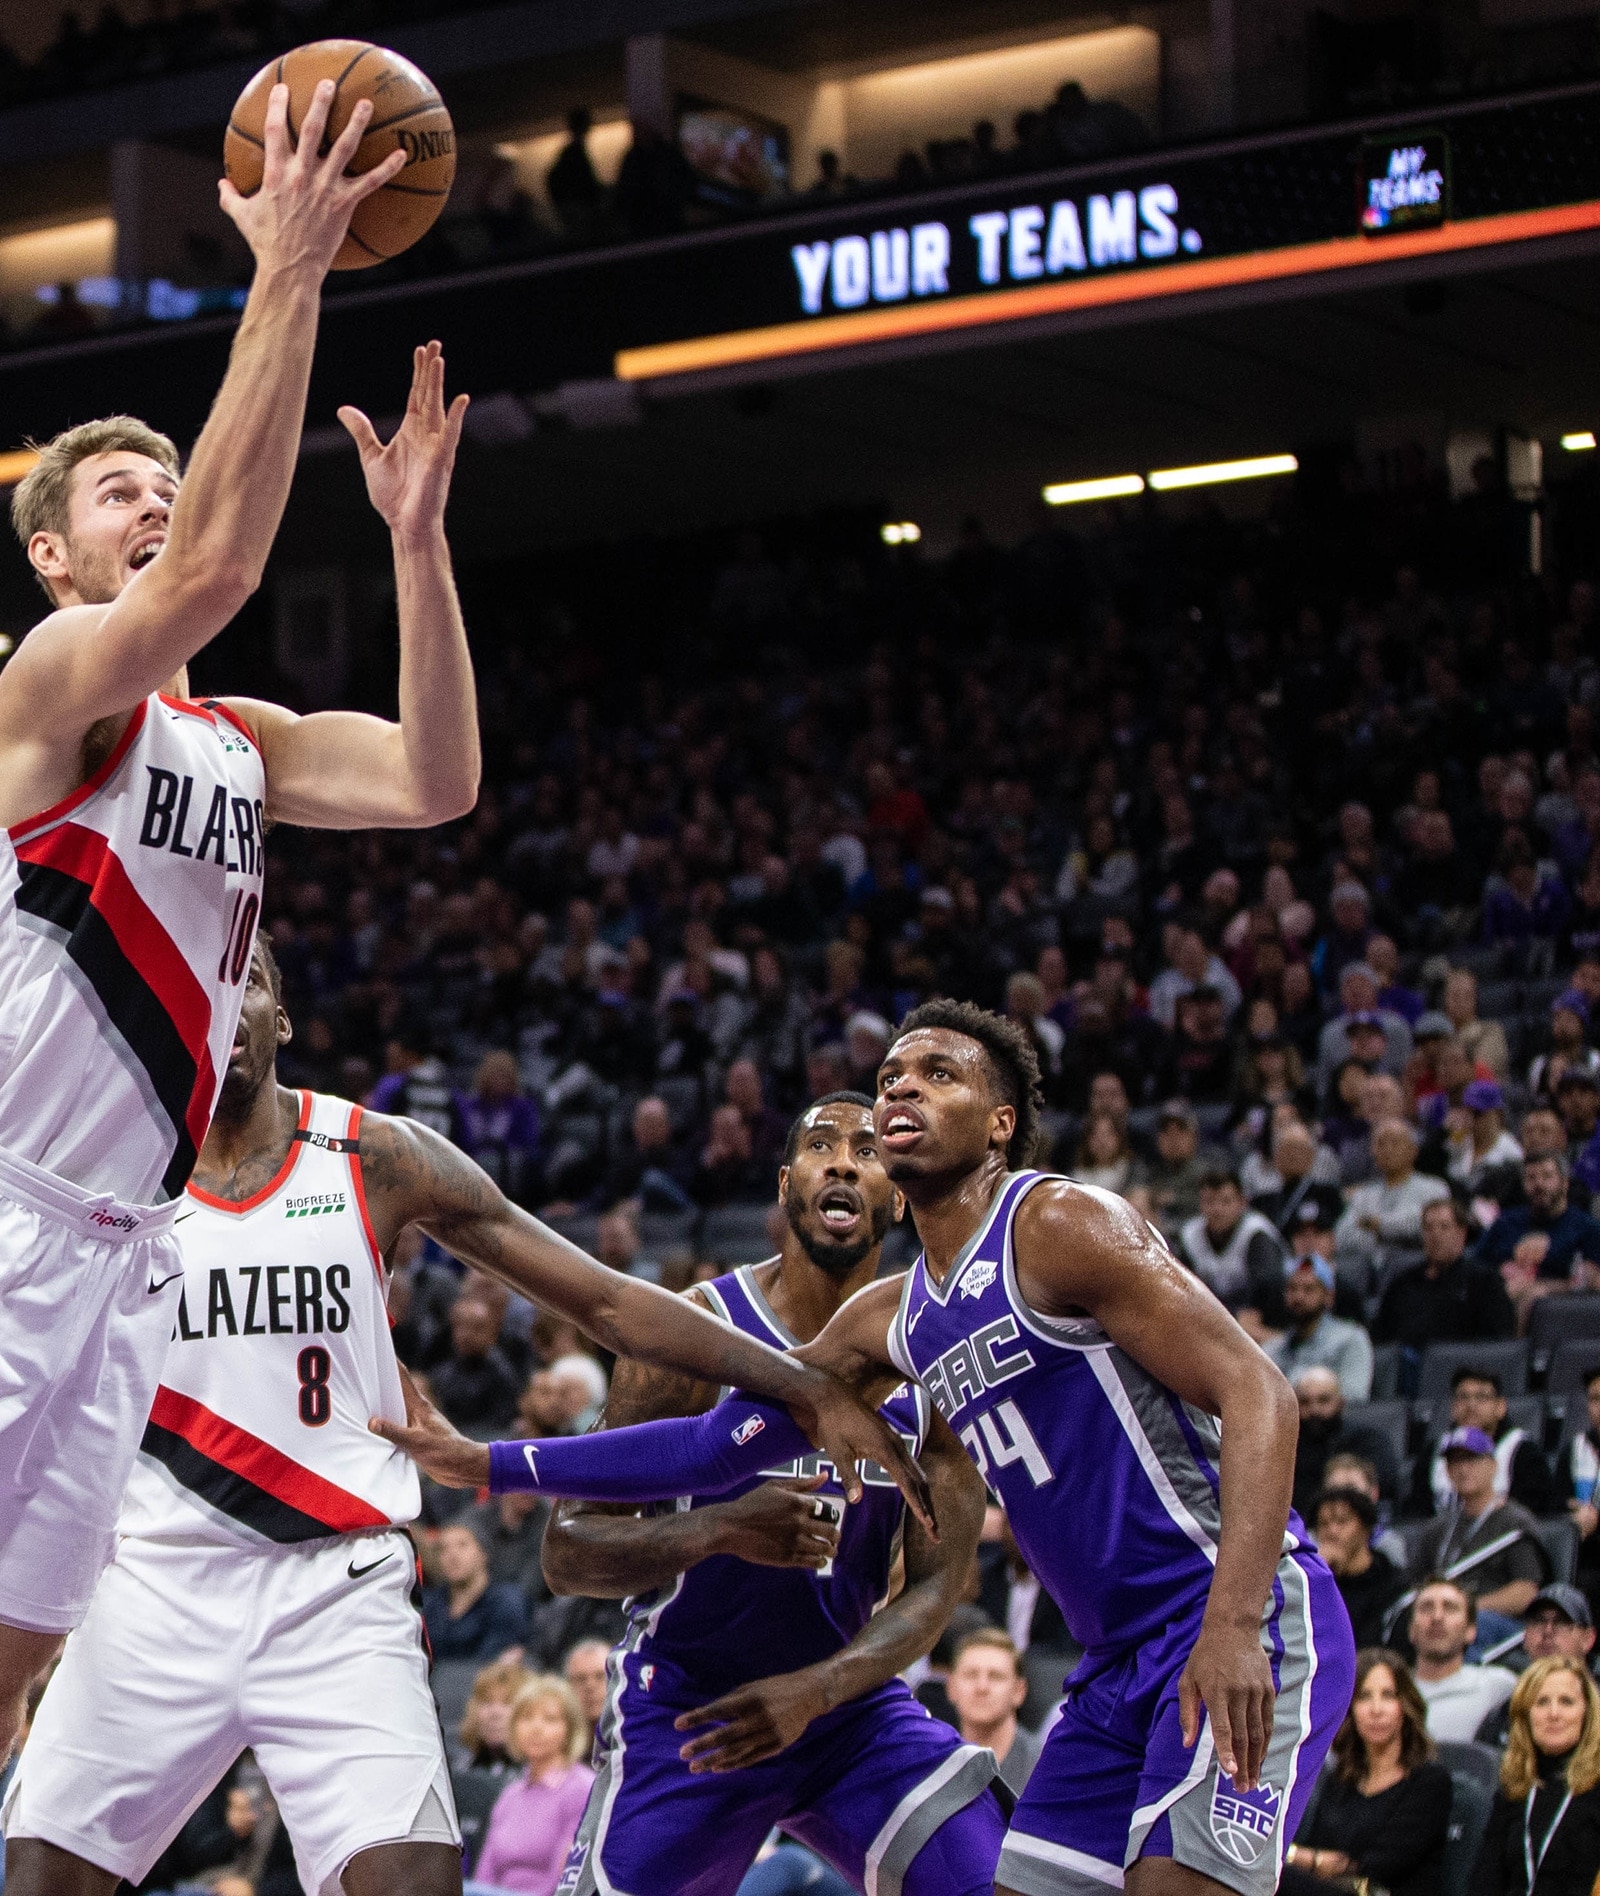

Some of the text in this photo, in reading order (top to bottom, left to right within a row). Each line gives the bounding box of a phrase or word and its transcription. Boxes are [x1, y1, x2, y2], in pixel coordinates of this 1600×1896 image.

[1387, 145, 1428, 180] MY
[791, 183, 1202, 315] YOUR TEAMS.
[218, 888, 260, 986] 10
[309, 1132, 330, 1149] PGA
[171, 1263, 351, 1343] LAZERS
[296, 1345, 332, 1428] 8
[920, 1313, 1037, 1424] SAC
[1212, 1796, 1275, 1838] SAC
